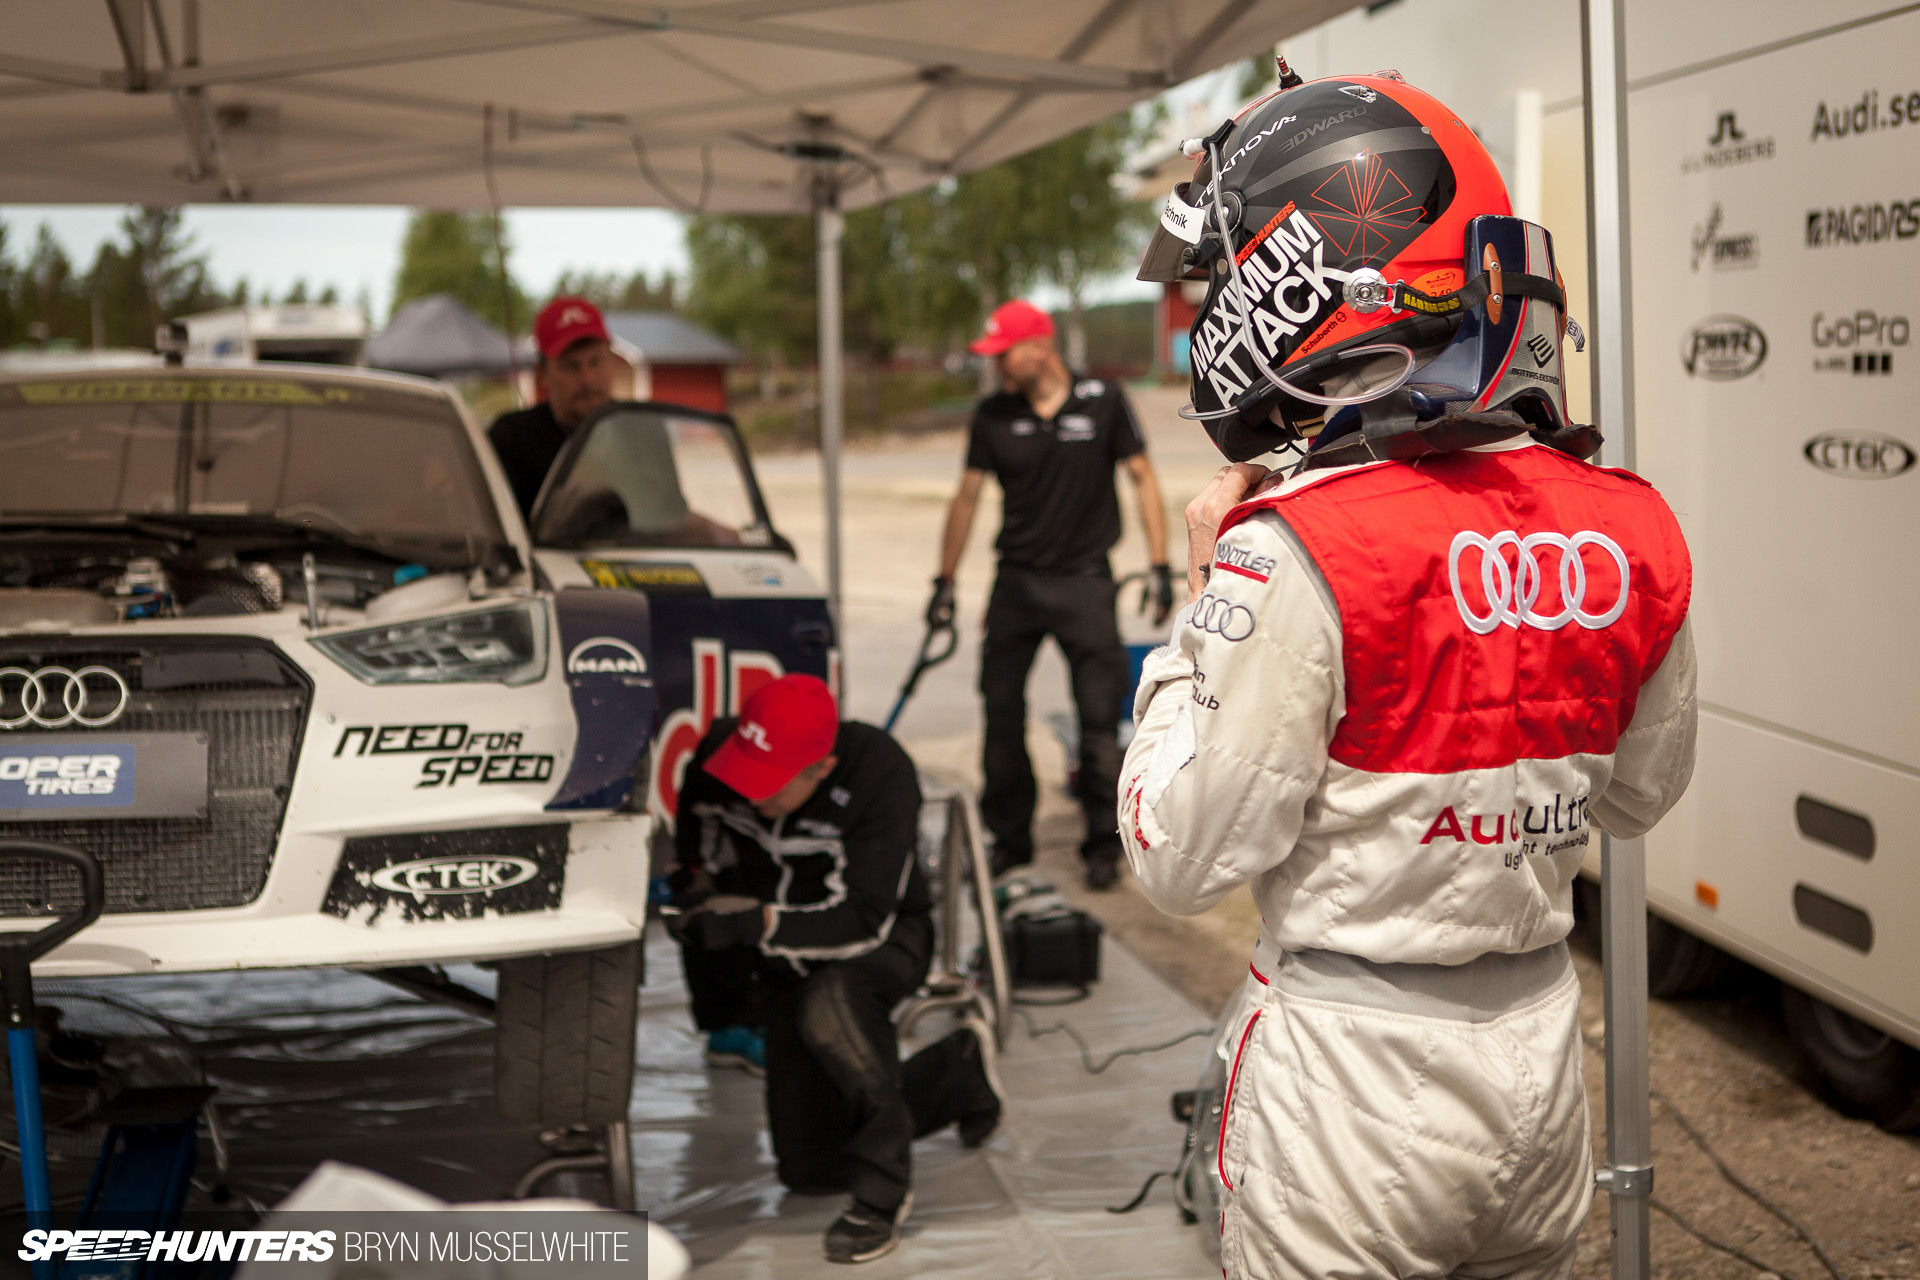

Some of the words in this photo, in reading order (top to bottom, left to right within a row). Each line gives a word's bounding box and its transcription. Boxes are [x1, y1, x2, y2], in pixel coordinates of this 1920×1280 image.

[1811, 88, 1920, 142] Audi.se
[1190, 209, 1322, 381] MAXIMUM
[1301, 320, 1339, 355] Schuberth
[1812, 310, 1910, 347] GoPro
[1821, 438, 1889, 474] CTEK
[574, 657, 638, 673] MAN
[332, 724, 469, 758] NEED
[466, 732, 524, 752] FOR
[24, 777, 116, 796] TIRES
[414, 755, 555, 789] SPEED
[406, 862, 505, 890] CTEK
